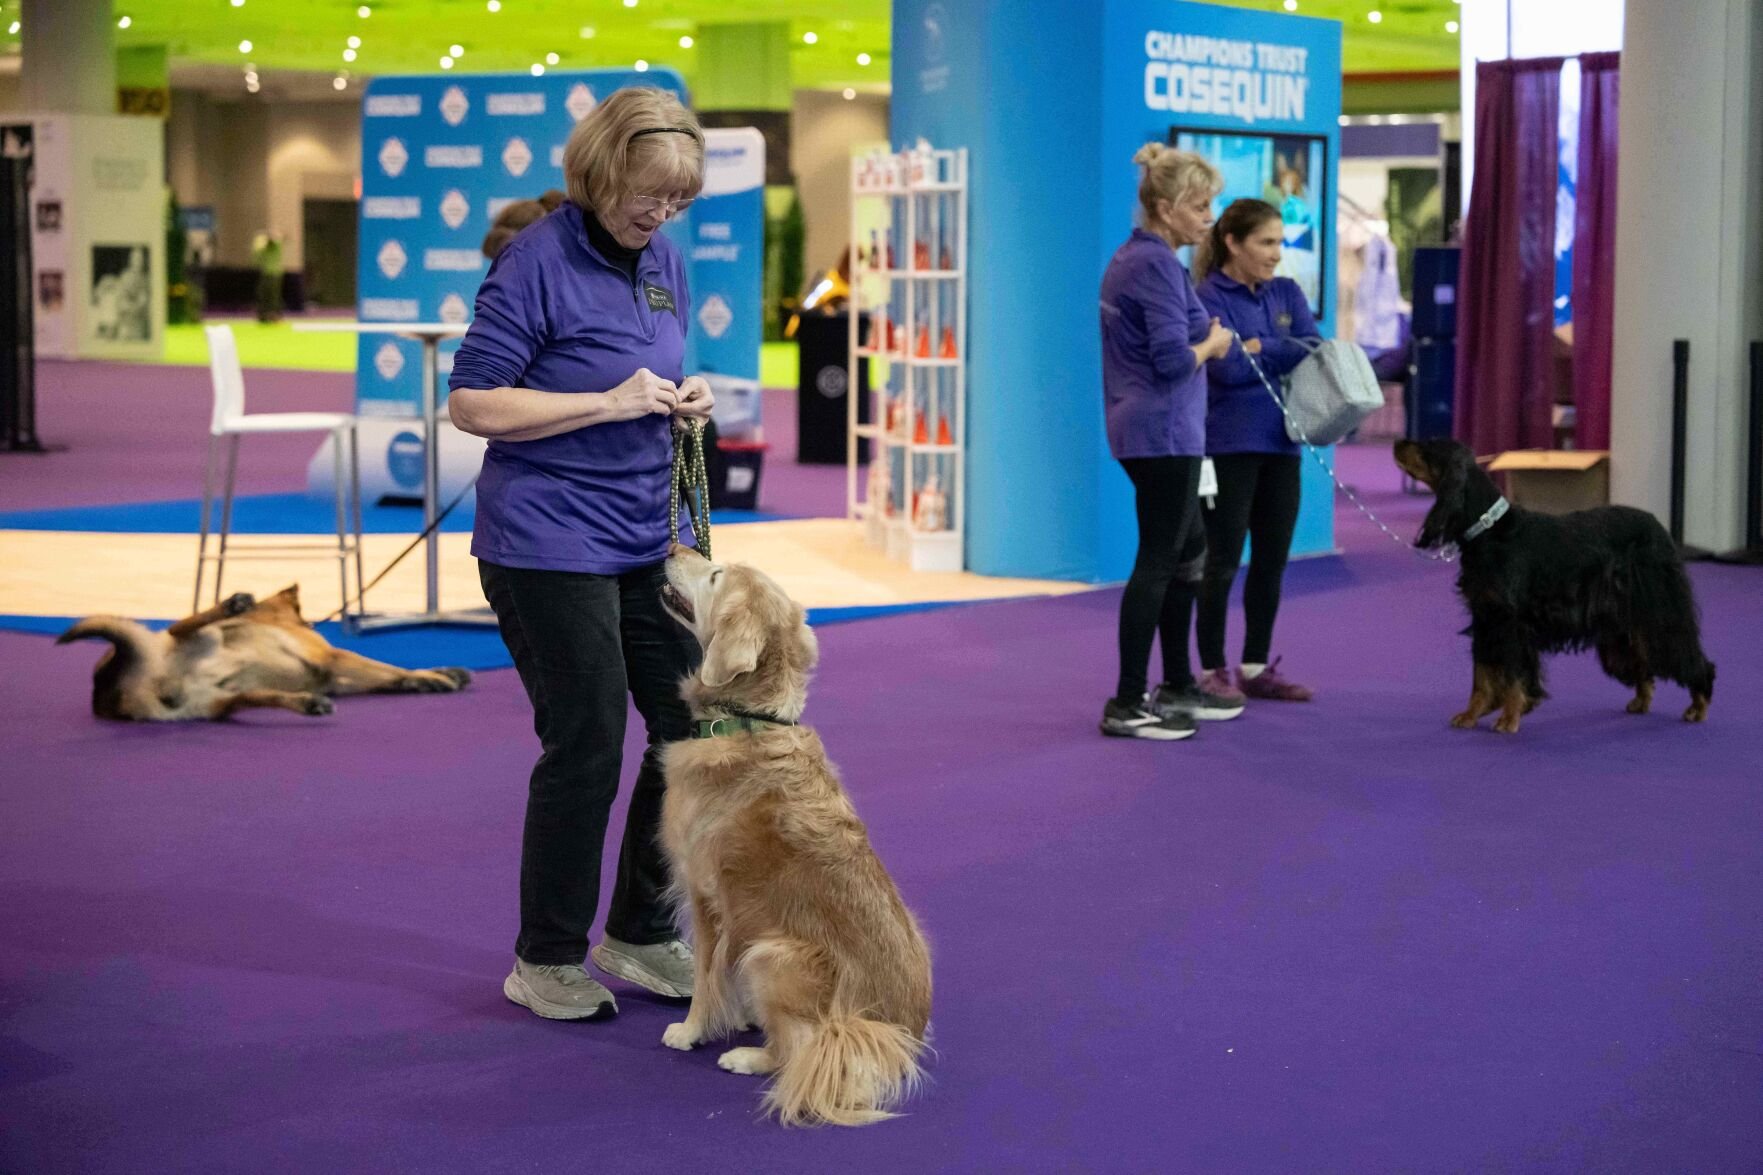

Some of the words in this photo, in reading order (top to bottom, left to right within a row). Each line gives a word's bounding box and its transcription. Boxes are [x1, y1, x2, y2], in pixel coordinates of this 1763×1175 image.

[1146, 31, 1253, 67] CHAMPIONS
[1257, 44, 1307, 73] TRUST
[1145, 62, 1305, 122] COSEQUIN
